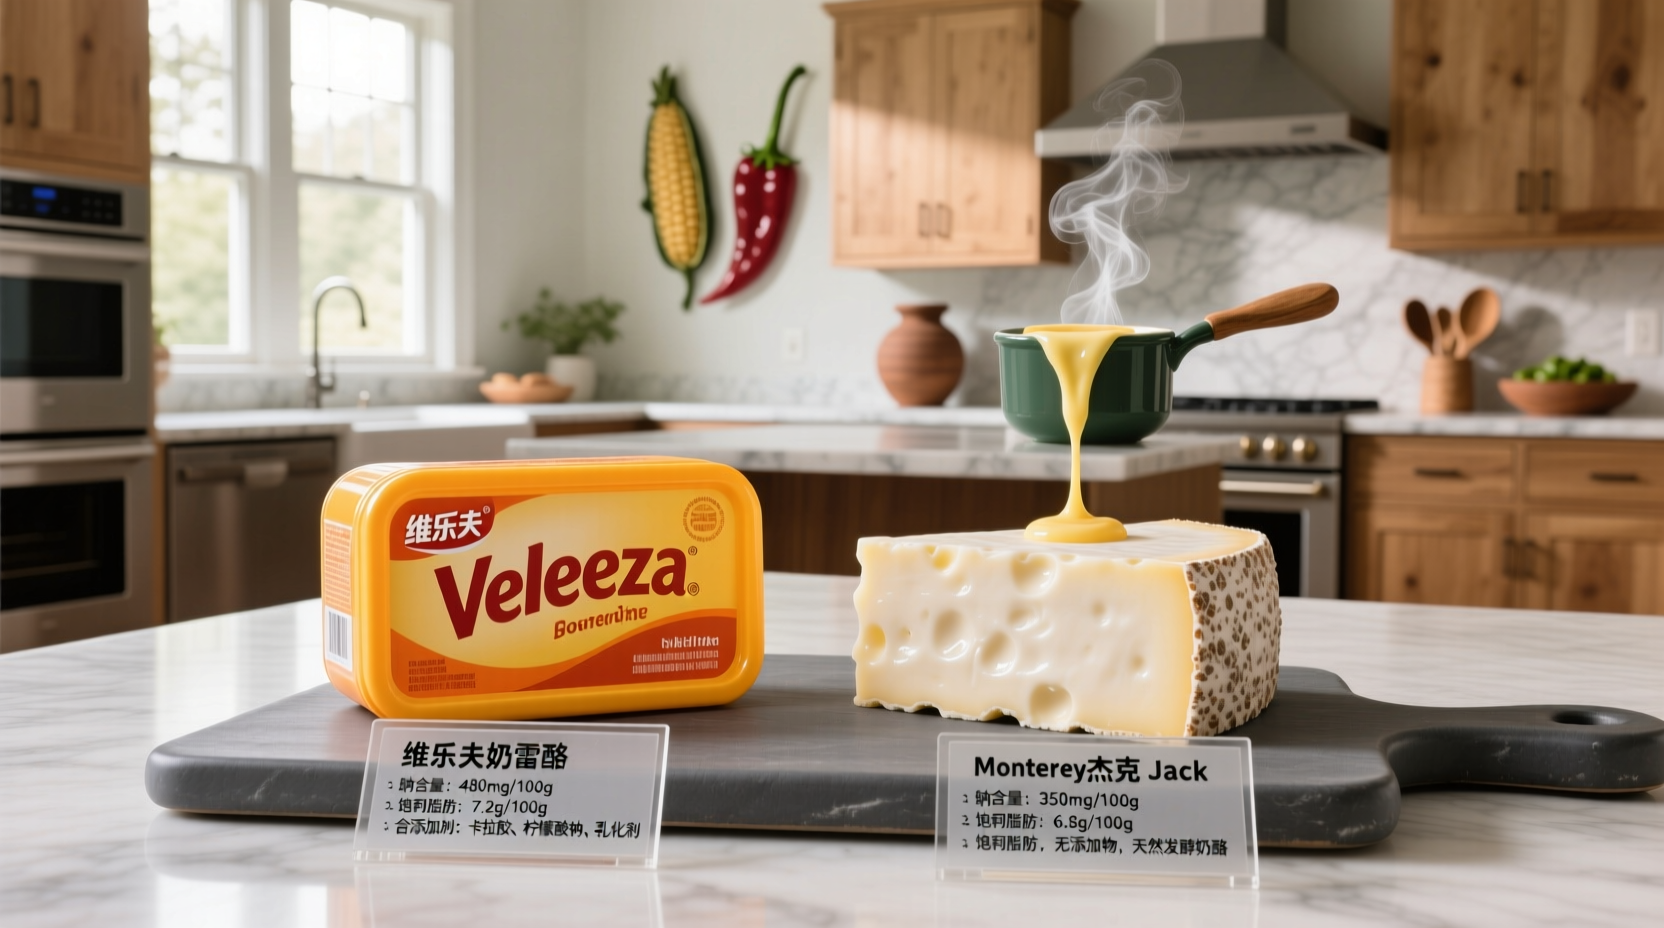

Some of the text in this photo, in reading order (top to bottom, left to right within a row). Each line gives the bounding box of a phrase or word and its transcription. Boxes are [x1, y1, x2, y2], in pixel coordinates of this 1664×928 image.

[405, 510, 482, 544] 维乐夫
[434, 542, 687, 640] Veleeza
[1148, 759, 1208, 782] Jack
